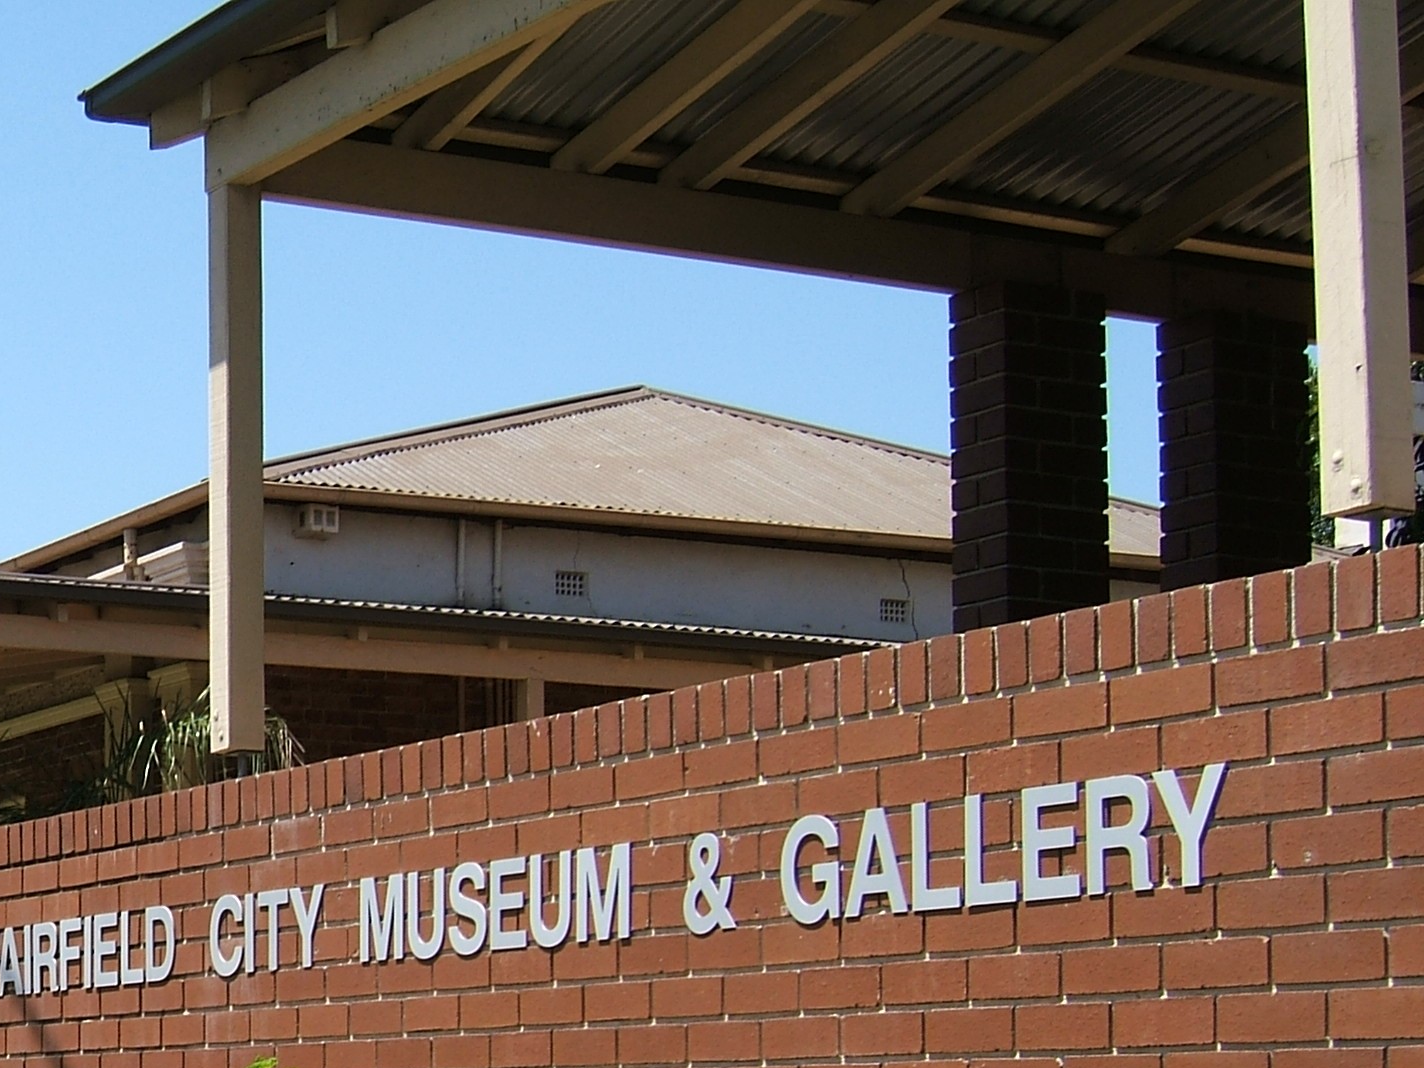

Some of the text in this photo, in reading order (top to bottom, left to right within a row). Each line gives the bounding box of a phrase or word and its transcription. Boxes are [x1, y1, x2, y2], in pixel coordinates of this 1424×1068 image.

[209, 885, 325, 977] CITY
[359, 842, 631, 963] MUSEUM
[683, 832, 737, 936] &
[780, 762, 1228, 925] GALLERY
